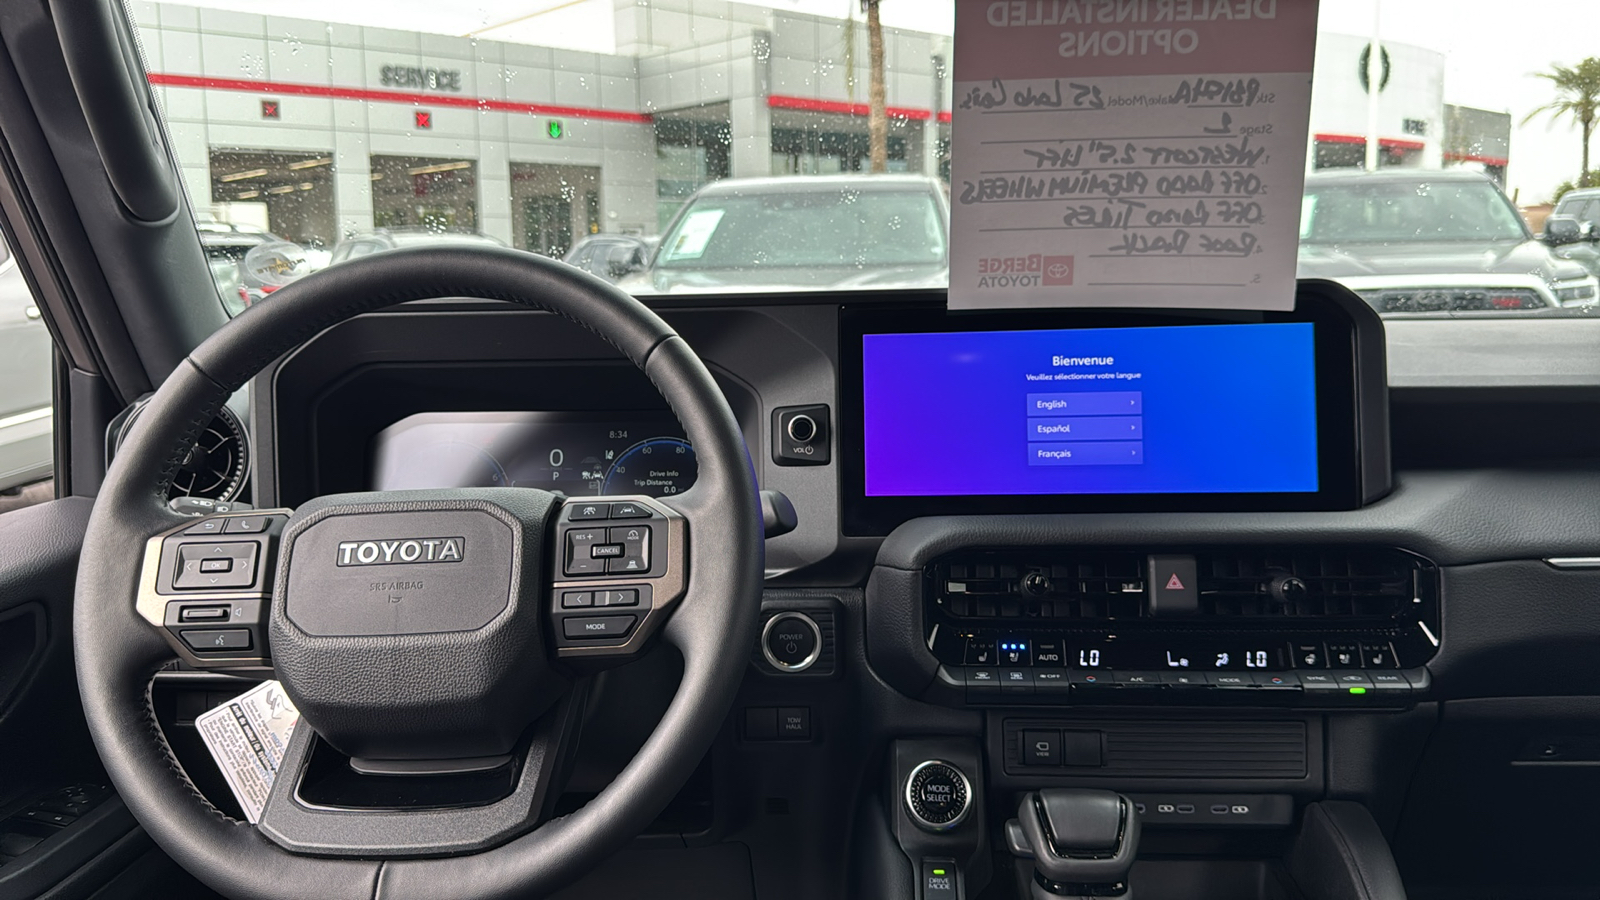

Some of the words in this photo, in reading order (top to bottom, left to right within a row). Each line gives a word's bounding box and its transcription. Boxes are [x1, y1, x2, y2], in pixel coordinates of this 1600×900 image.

[381, 64, 461, 93] SERVICE
[1052, 355, 1114, 366] Bienvenue
[1026, 373, 1053, 381] Veuillez
[1054, 372, 1096, 381] sélectionner
[1116, 372, 1141, 380] langue
[1037, 400, 1067, 410] English
[1037, 424, 1070, 434] Español
[609, 430, 628, 439] 8:34
[642, 446, 652, 454] 60
[675, 446, 686, 454] 80
[1038, 449, 1071, 459] Français
[549, 448, 564, 467] 0
[552, 471, 560, 481] P
[663, 486, 677, 494] 0.0
[340, 540, 460, 565] TOYOTA
[596, 546, 620, 554] CANCEL
[210, 561, 221, 569] OK
[369, 581, 387, 592] SRS
[389, 581, 424, 591] AIRBAG
[585, 623, 606, 631] MODE
[1038, 653, 1058, 661] AUTO
[927, 784, 950, 792] MODE
[926, 793, 951, 802] SELECT
